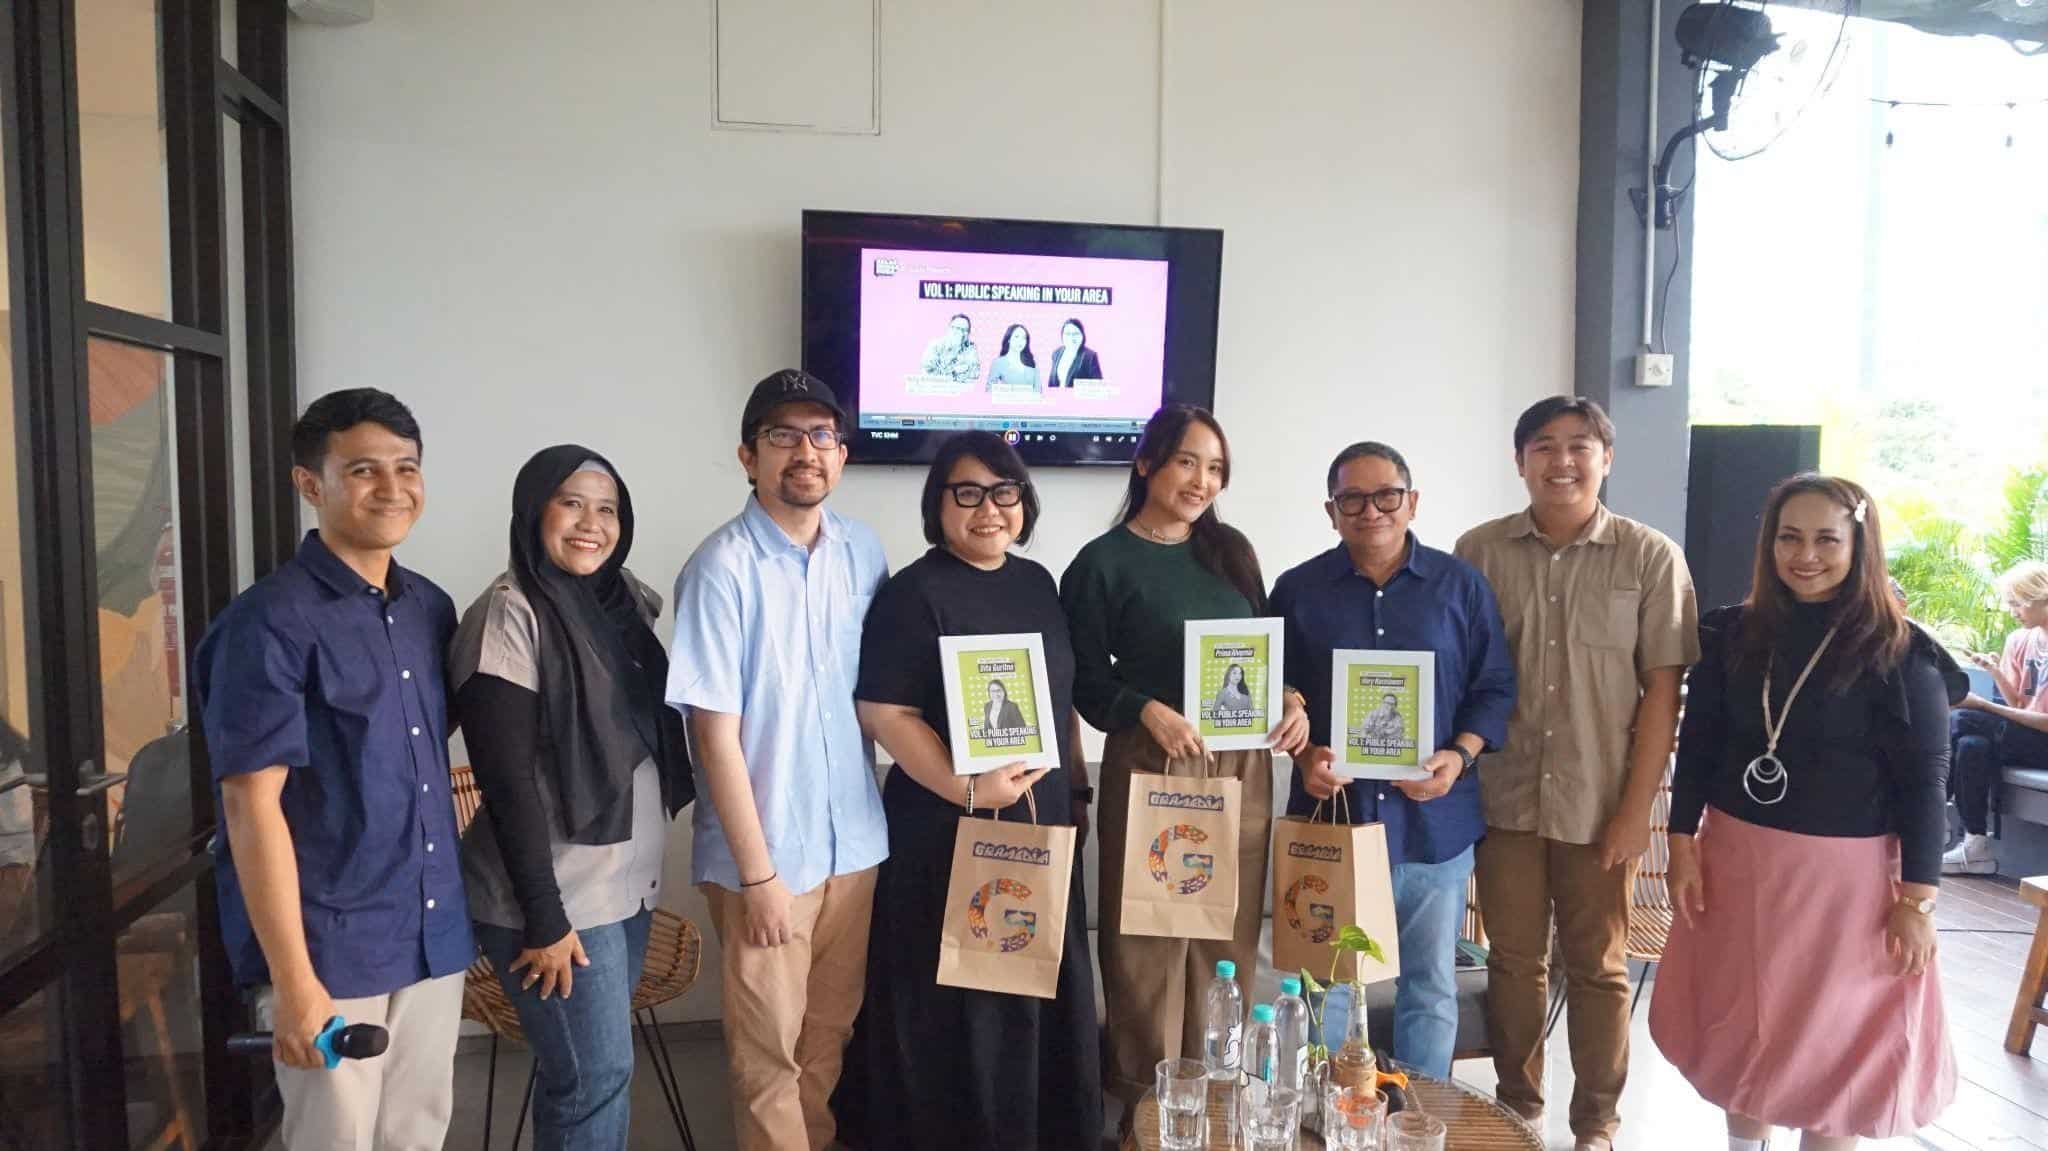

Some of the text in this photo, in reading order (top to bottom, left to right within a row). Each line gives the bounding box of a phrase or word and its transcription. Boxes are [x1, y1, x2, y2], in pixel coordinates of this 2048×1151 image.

[924, 282, 1108, 304] VOL 1: PUBLIC SPEAKING IN YOUR AREA
[1219, 710, 1237, 719] PUBLIC
[1238, 709, 1264, 718] SPEAKING
[988, 727, 1008, 737] PUBLIC
[1008, 726, 1038, 736] SPEAKING
[1366, 738, 1385, 747] PUBLIC
